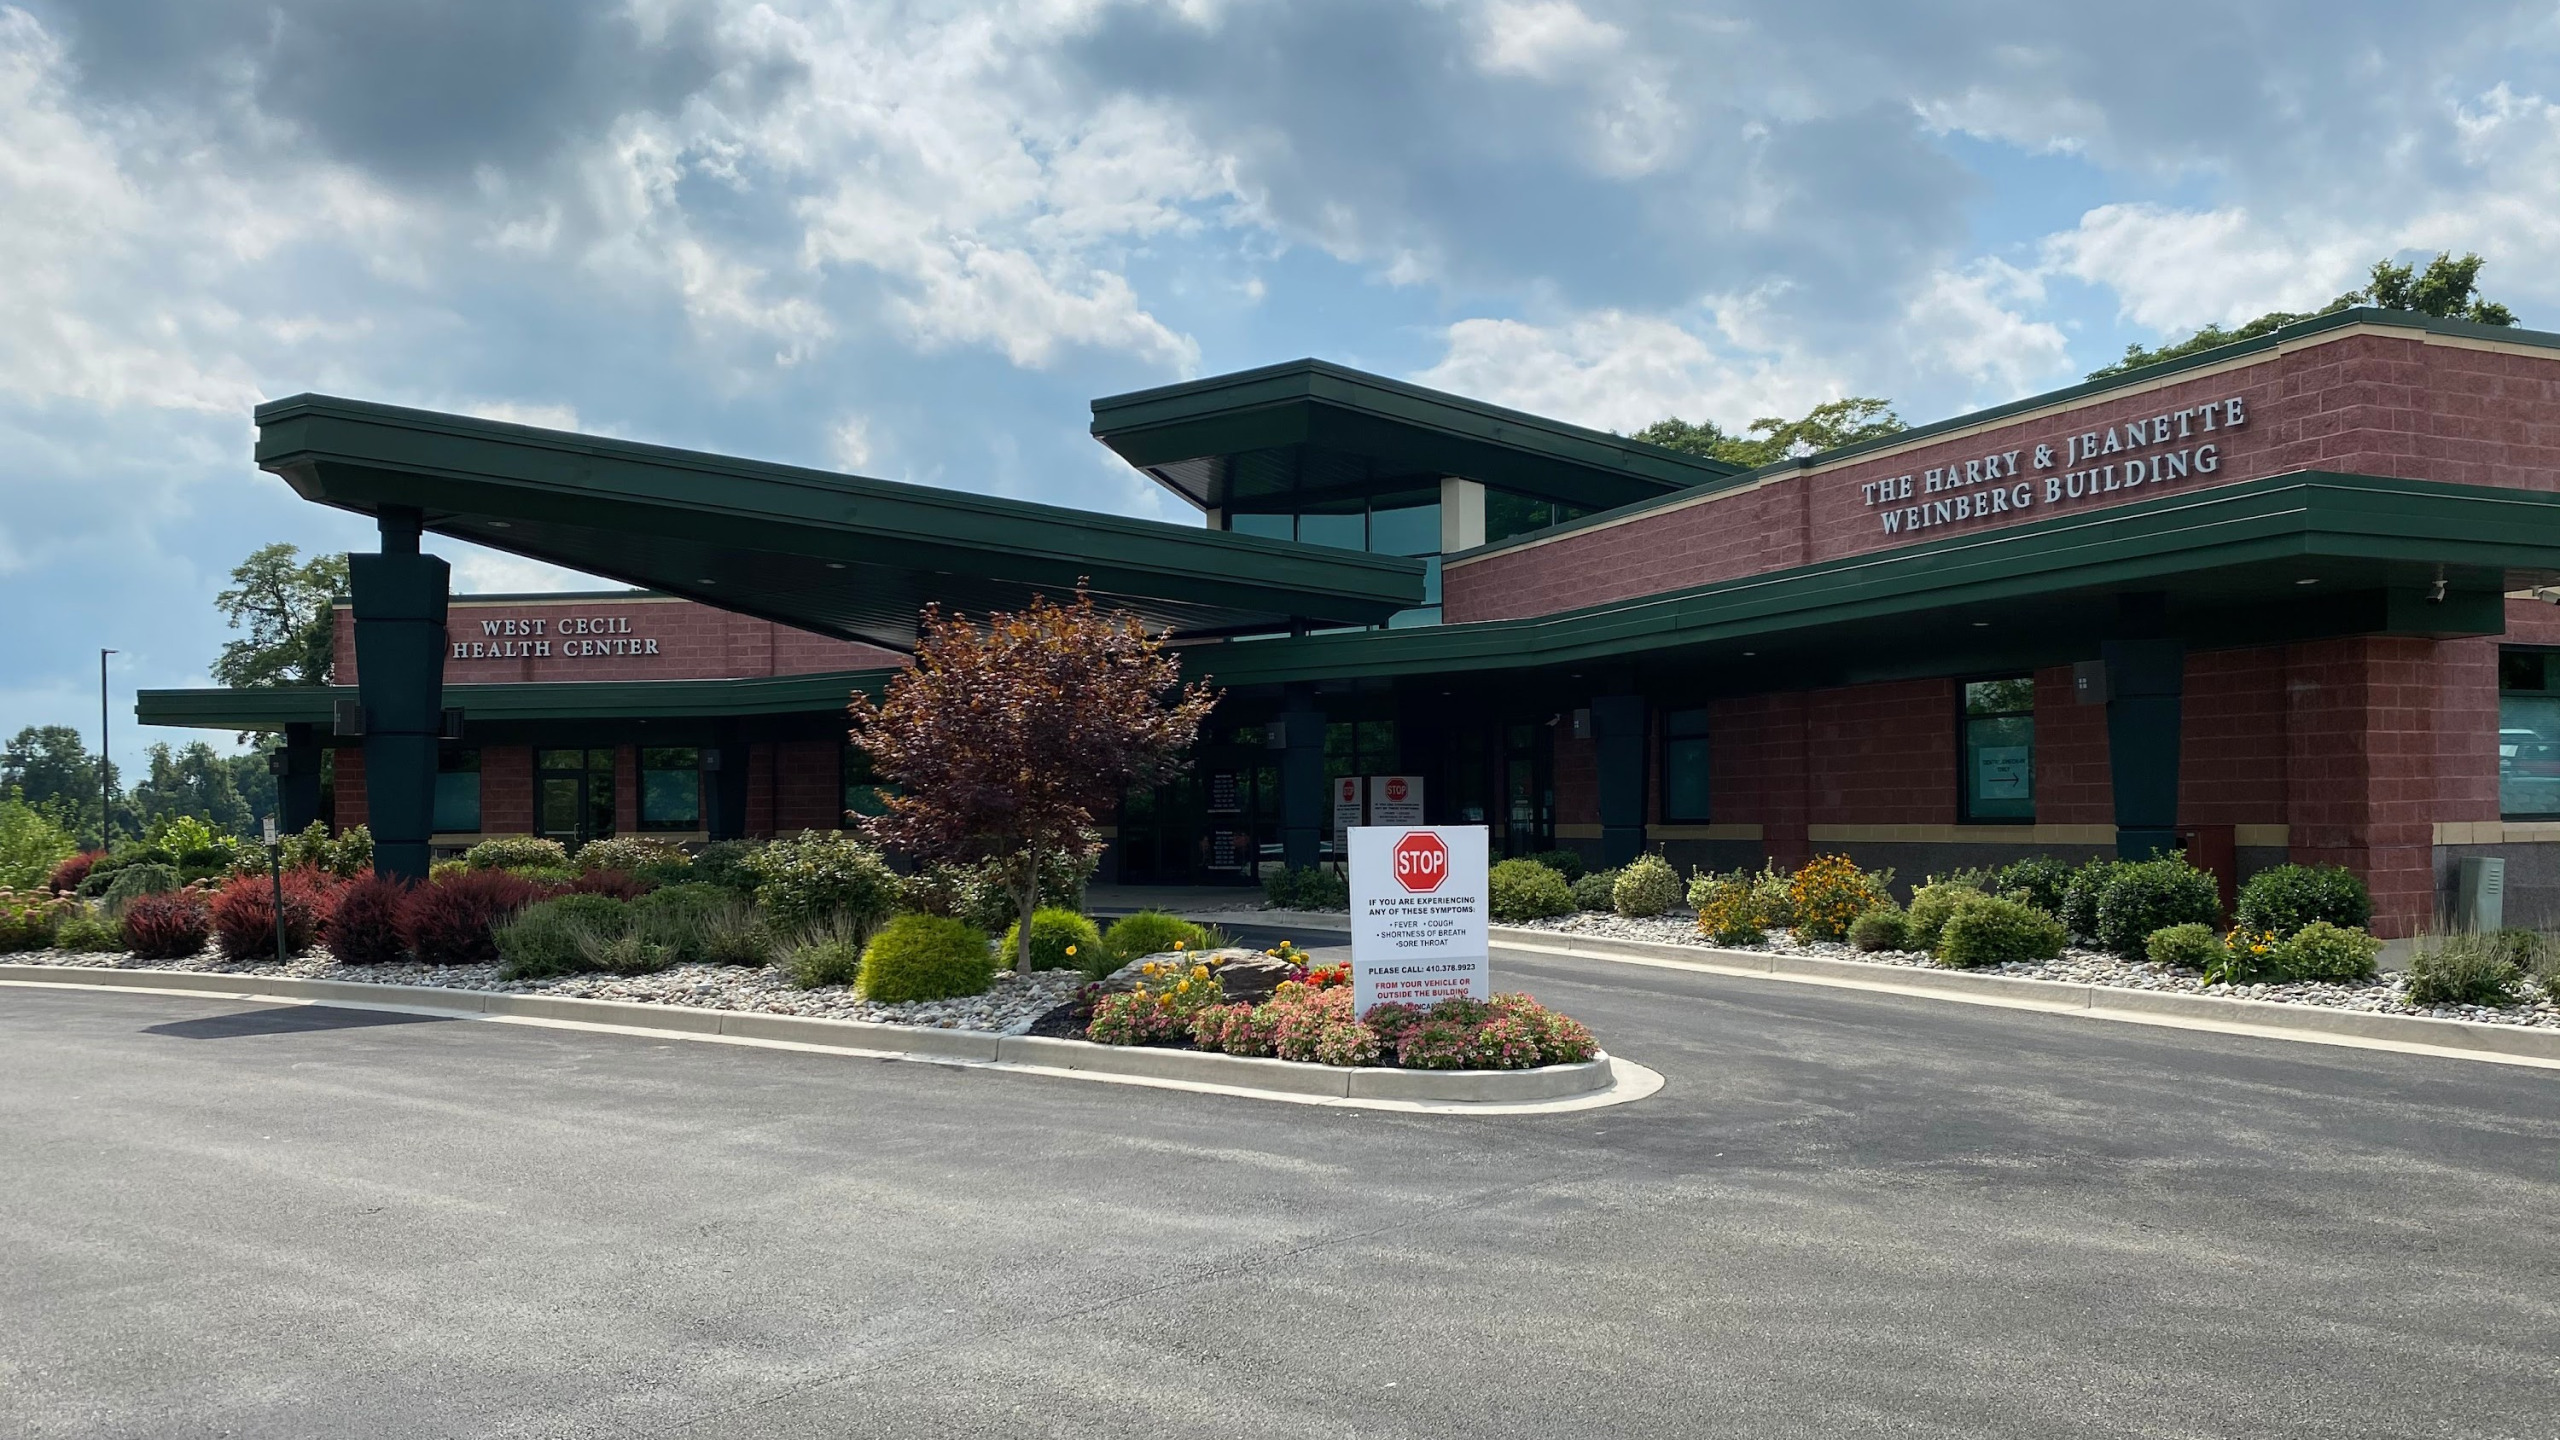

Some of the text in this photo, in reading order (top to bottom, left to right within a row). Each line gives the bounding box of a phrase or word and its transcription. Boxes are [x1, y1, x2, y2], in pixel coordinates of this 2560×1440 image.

[1861, 396, 2246, 506] THE HARRY & JEANETTE
[1880, 444, 2220, 535] WEINBERG BUILDING
[481, 617, 632, 636] WEST CECIL
[452, 638, 660, 659] HEALTH CENTER
[1387, 785, 1406, 795] STOP
[1399, 850, 1444, 875] STOP
[1379, 898, 1396, 906] YOU
[1398, 897, 1415, 905] ARE
[1417, 896, 1476, 905] EXPERIENCING
[1369, 908, 1386, 916] ANY
[1401, 907, 1428, 915] THESE
[1427, 920, 1454, 928] COUGH
[1381, 930, 1426, 938] SHORTNESS
[1438, 929, 1466, 937] BREATH
[1420, 939, 1448, 947] THROAT
[1368, 963, 1476, 975] PLEASE CALL: 410.378.9923
[1400, 980, 1422, 988] YOUR
[1424, 979, 1457, 987] VEHICLE
[1377, 987, 1469, 999] OUTSIDE THE BUILDING
